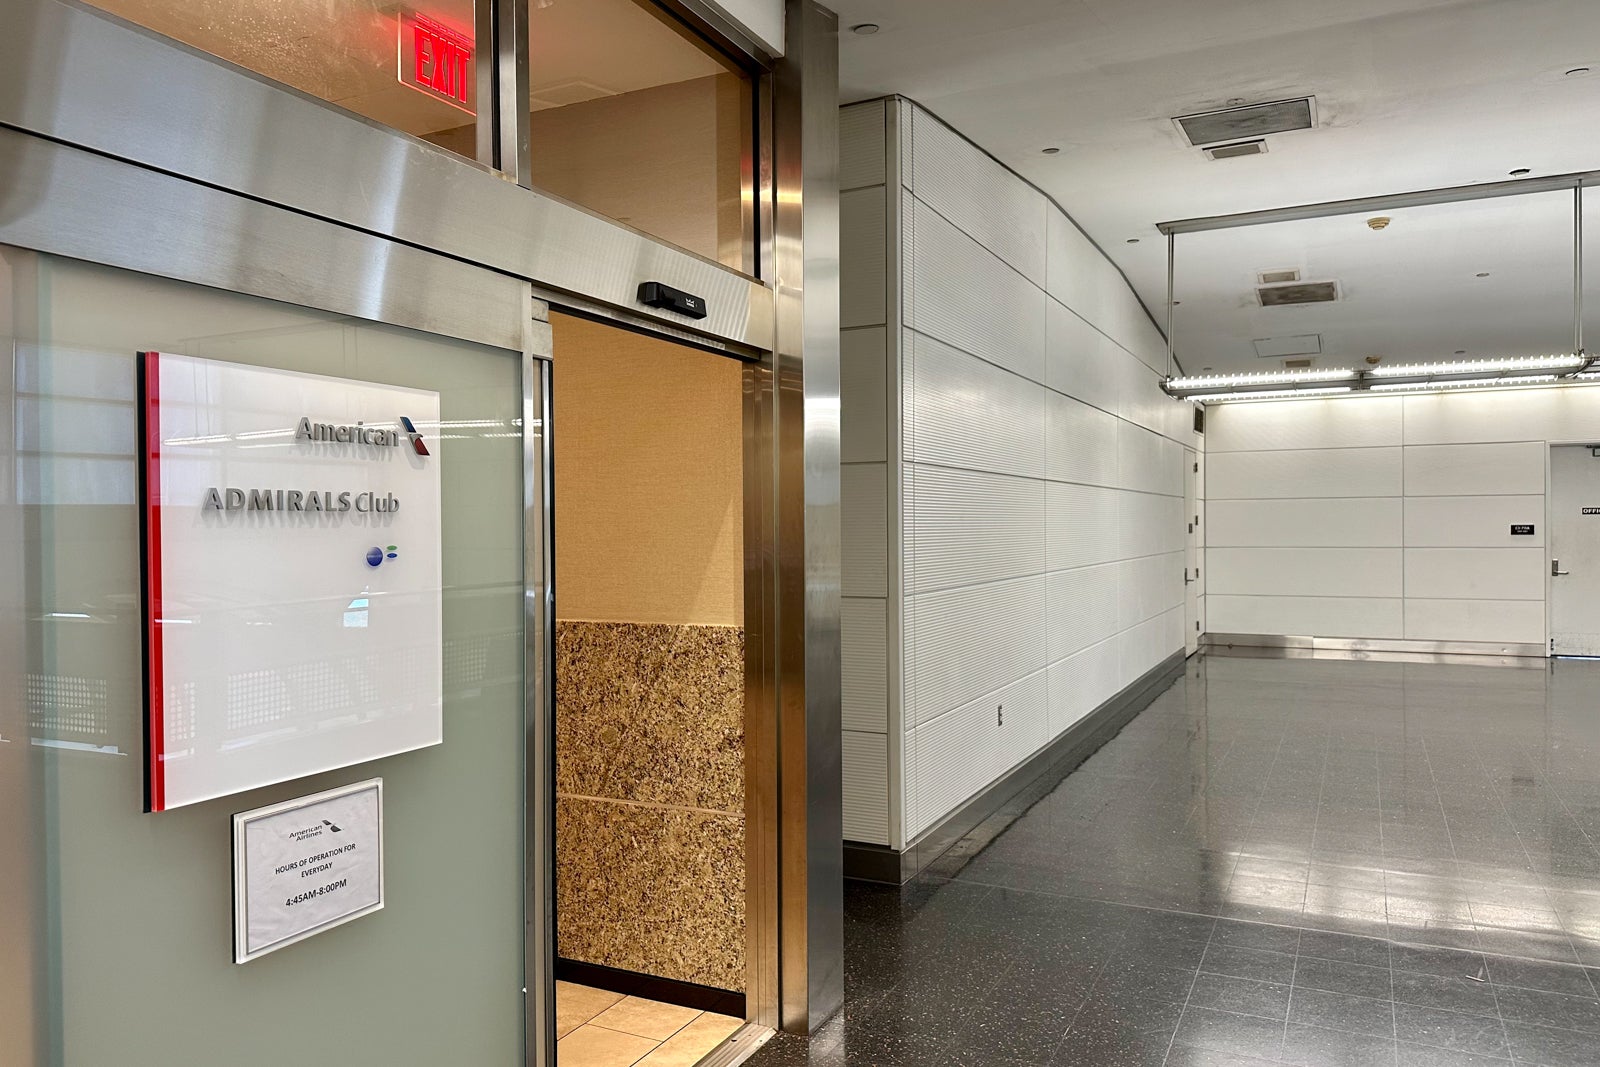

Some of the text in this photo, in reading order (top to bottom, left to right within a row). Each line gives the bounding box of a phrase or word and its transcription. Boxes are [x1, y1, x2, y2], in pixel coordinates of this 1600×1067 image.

[415, 25, 470, 104] EXIT
[295, 416, 399, 447] American
[203, 487, 400, 513] ADMIRALS Club
[288, 825, 323, 839] American
[296, 830, 323, 841] Airlines
[275, 843, 356, 875] HOURS OF OPERATION FOR
[301, 862, 333, 878] EVERYDAY
[285, 878, 347, 907] 4:45AM-8:00PM
